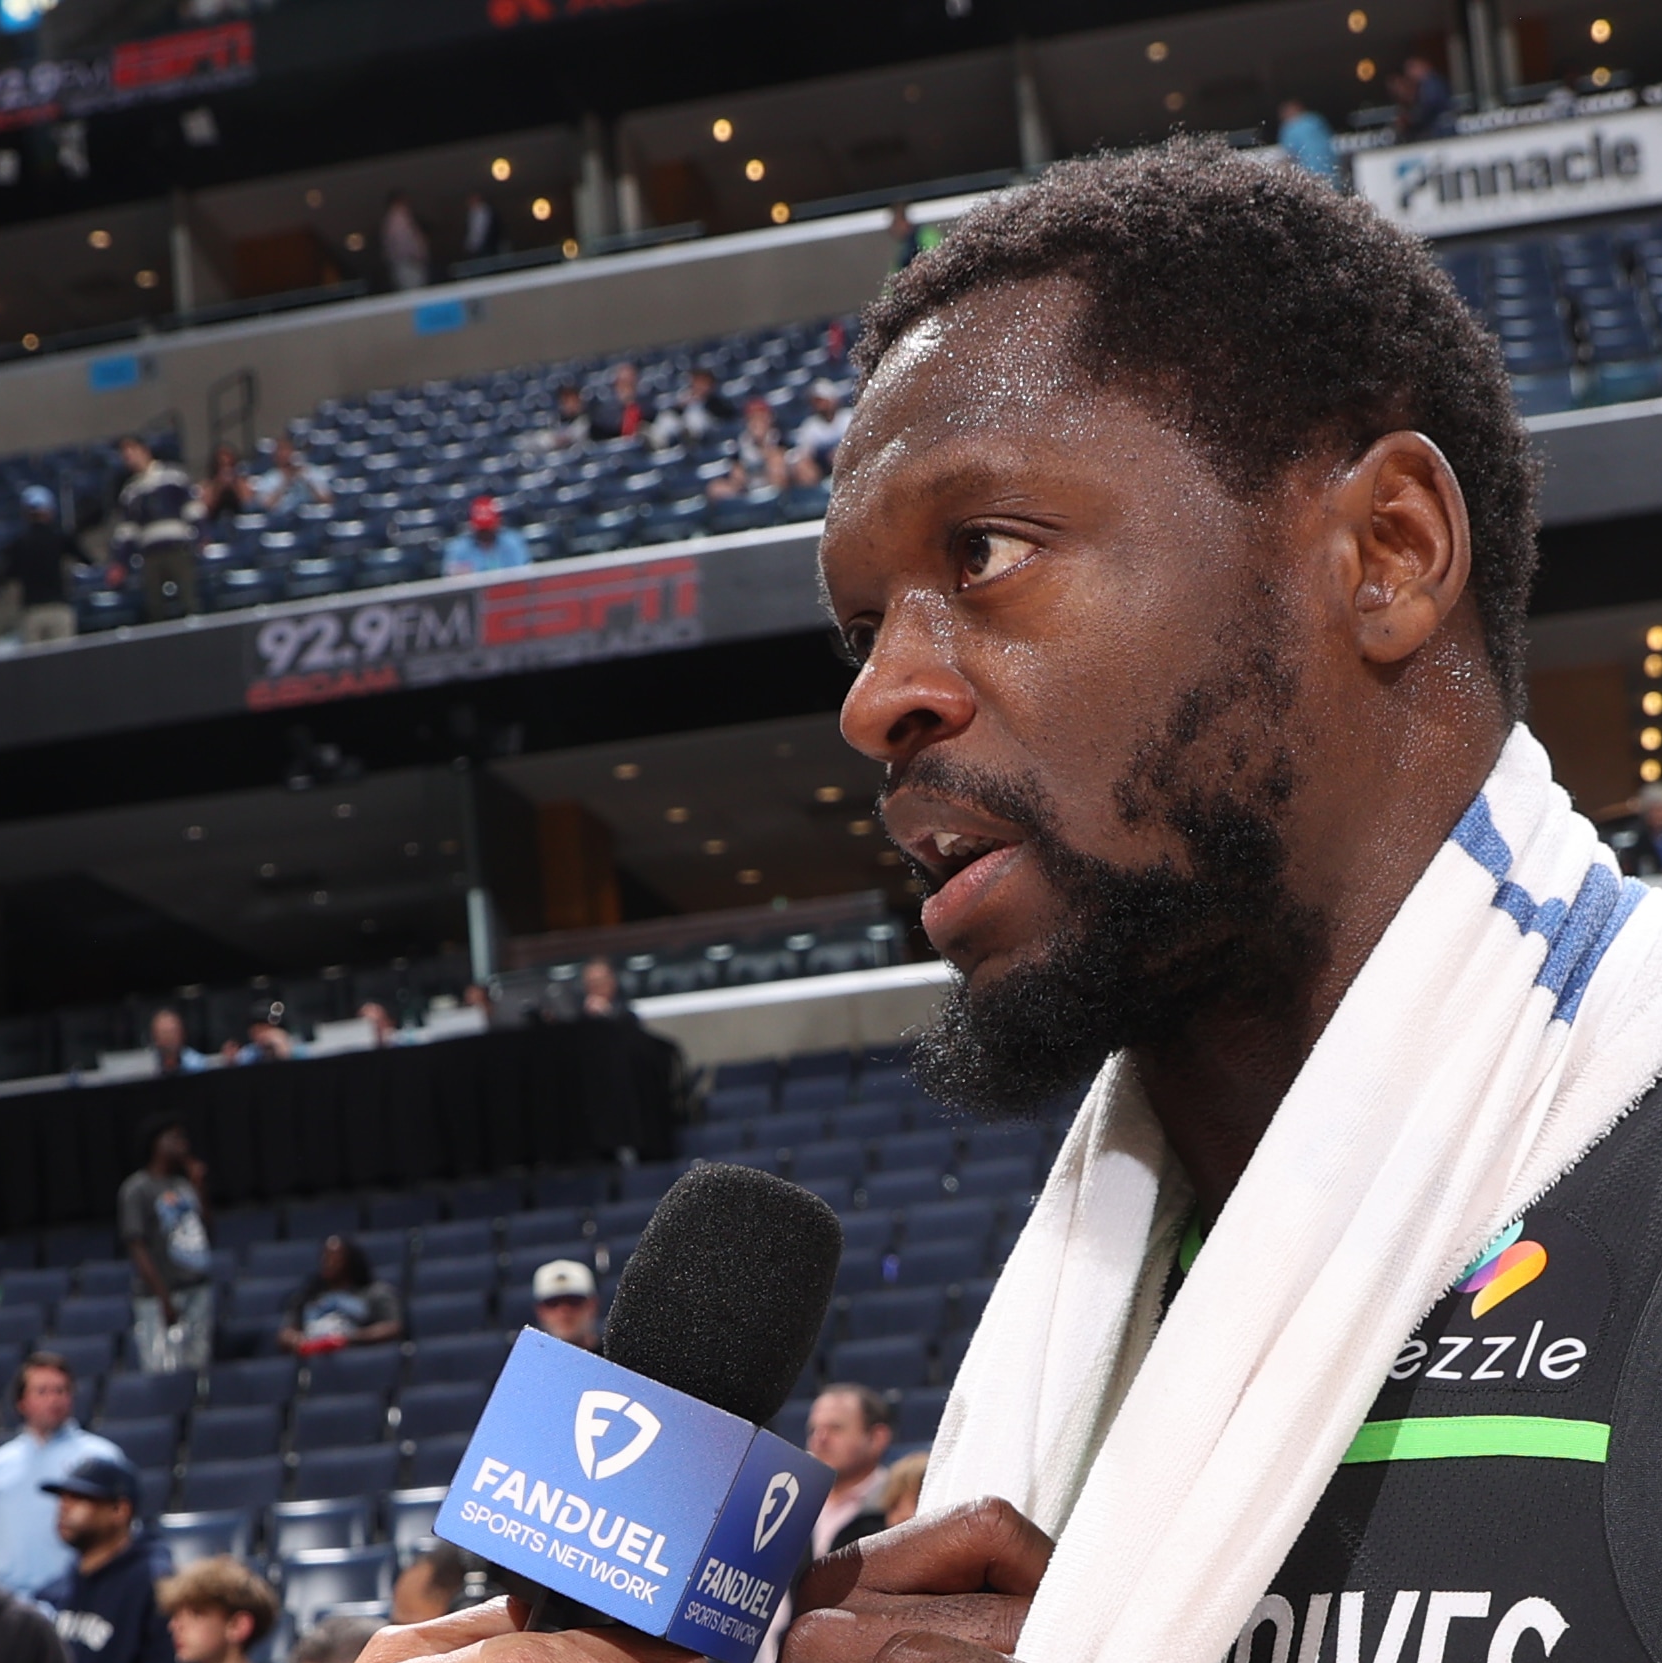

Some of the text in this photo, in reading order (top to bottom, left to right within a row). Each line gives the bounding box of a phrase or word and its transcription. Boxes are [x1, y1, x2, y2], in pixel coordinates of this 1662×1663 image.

[1397, 130, 1641, 210] Pinnacle
[256, 556, 699, 676] 92.9FM ESPN
[1389, 1319, 1587, 1380] ezzle
[459, 1500, 661, 1605] SPORTS NETWORK
[471, 1456, 670, 1577] FANDUEL
[684, 1601, 762, 1647] SPORTS NETWORK
[695, 1556, 776, 1620] FANDUEL
